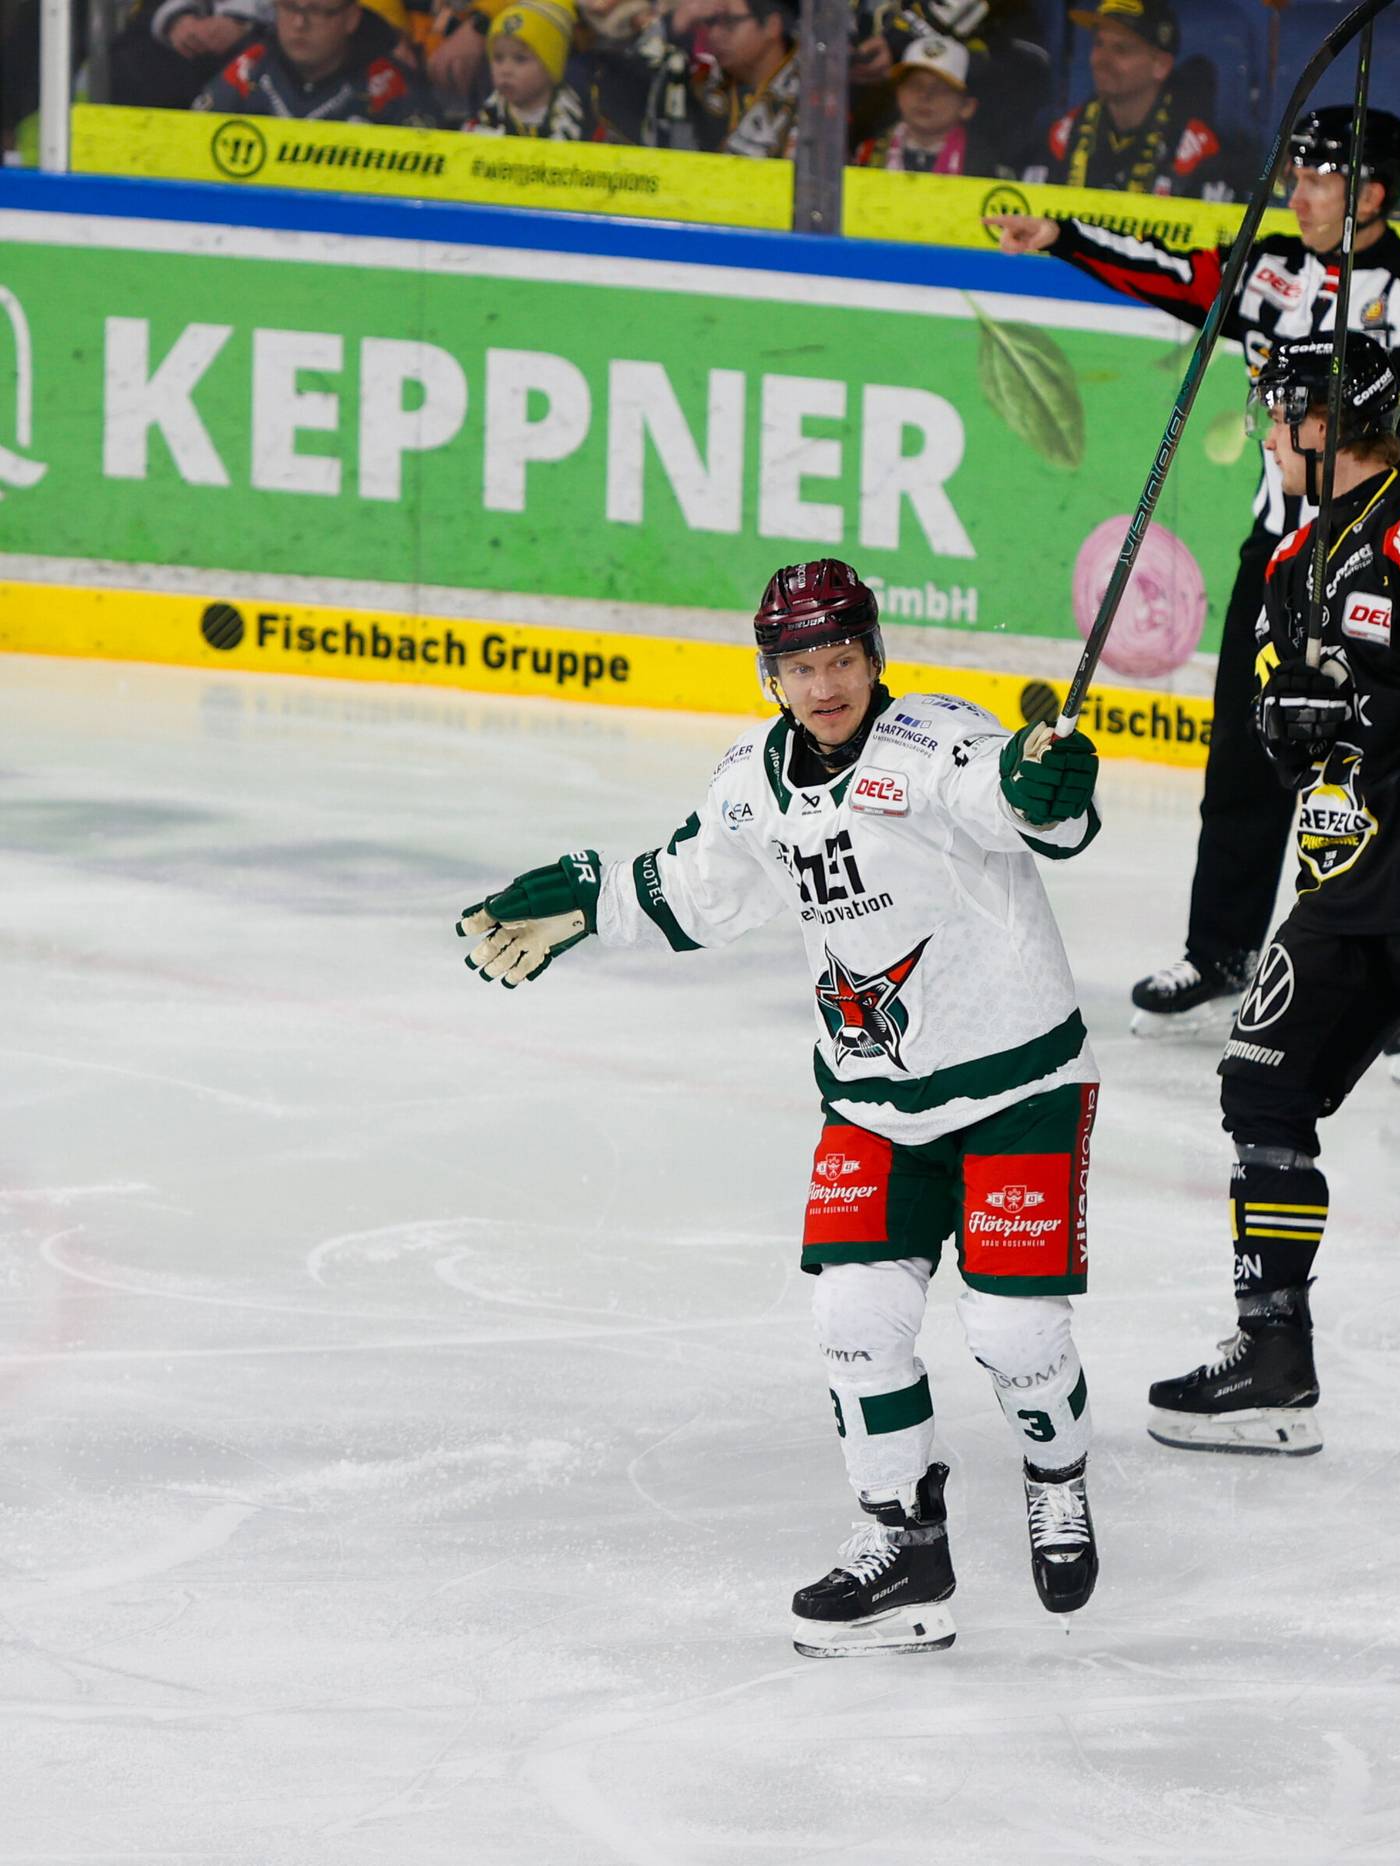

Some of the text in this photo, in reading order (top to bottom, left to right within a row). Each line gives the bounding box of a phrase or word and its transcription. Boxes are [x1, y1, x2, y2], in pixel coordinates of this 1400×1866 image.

[275, 141, 447, 177] WARRIOR
[102, 315, 978, 559] KEPPNER
[256, 612, 631, 689] Fischbach Gruppe
[875, 721, 940, 752] HARTINGER
[968, 1210, 1063, 1234] Flötzinger
[1016, 1408, 1057, 1443] 3
